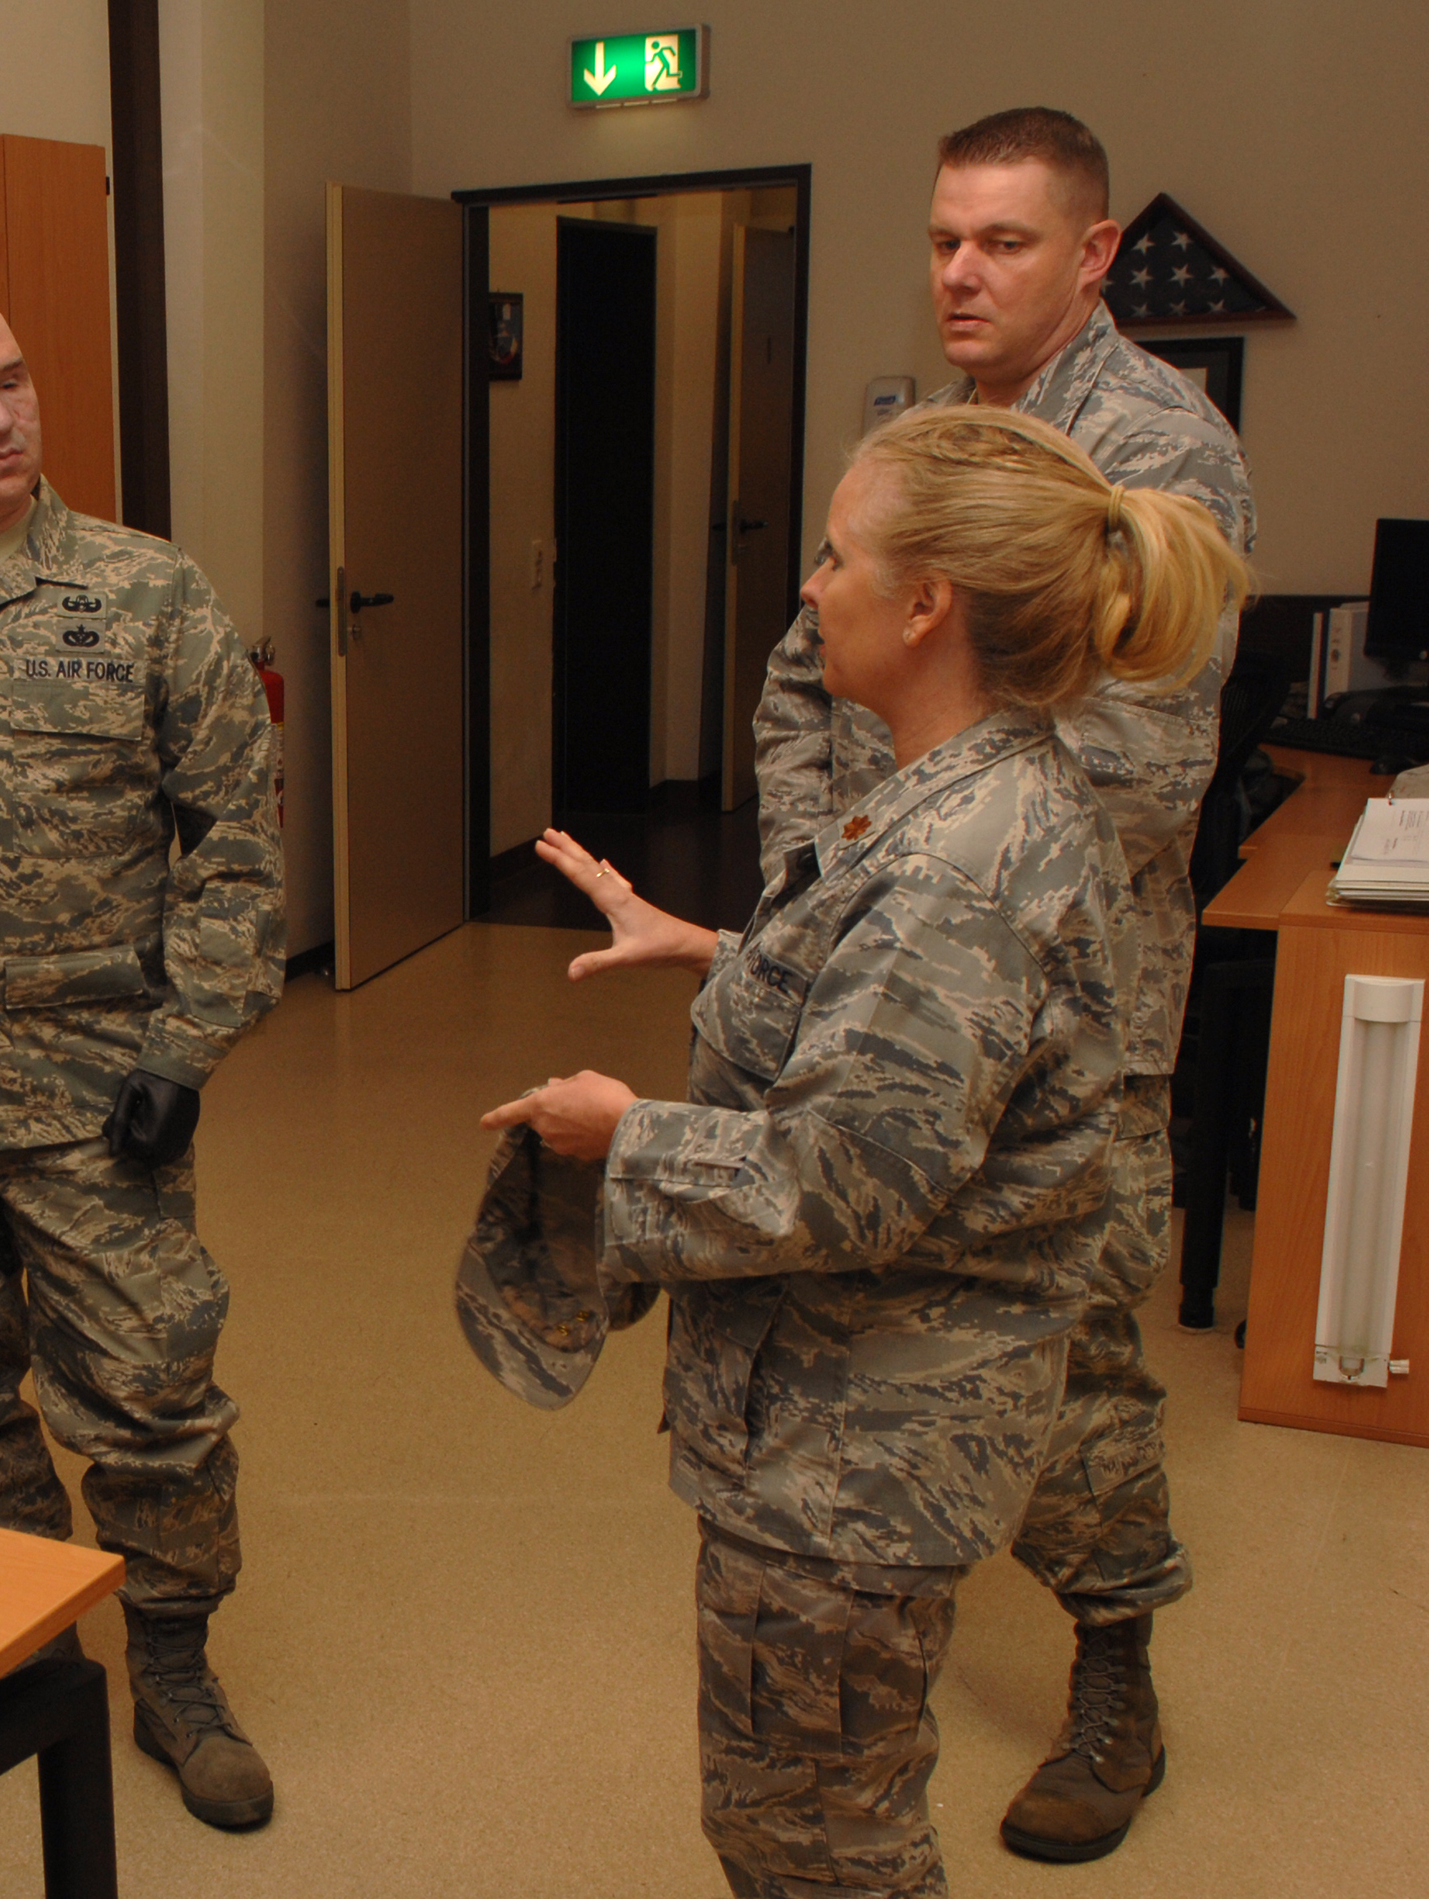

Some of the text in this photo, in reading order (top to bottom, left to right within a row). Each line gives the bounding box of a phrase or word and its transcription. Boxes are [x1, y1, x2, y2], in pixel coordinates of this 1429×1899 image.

[26, 659, 135, 683] U.S. AIR FORCE
